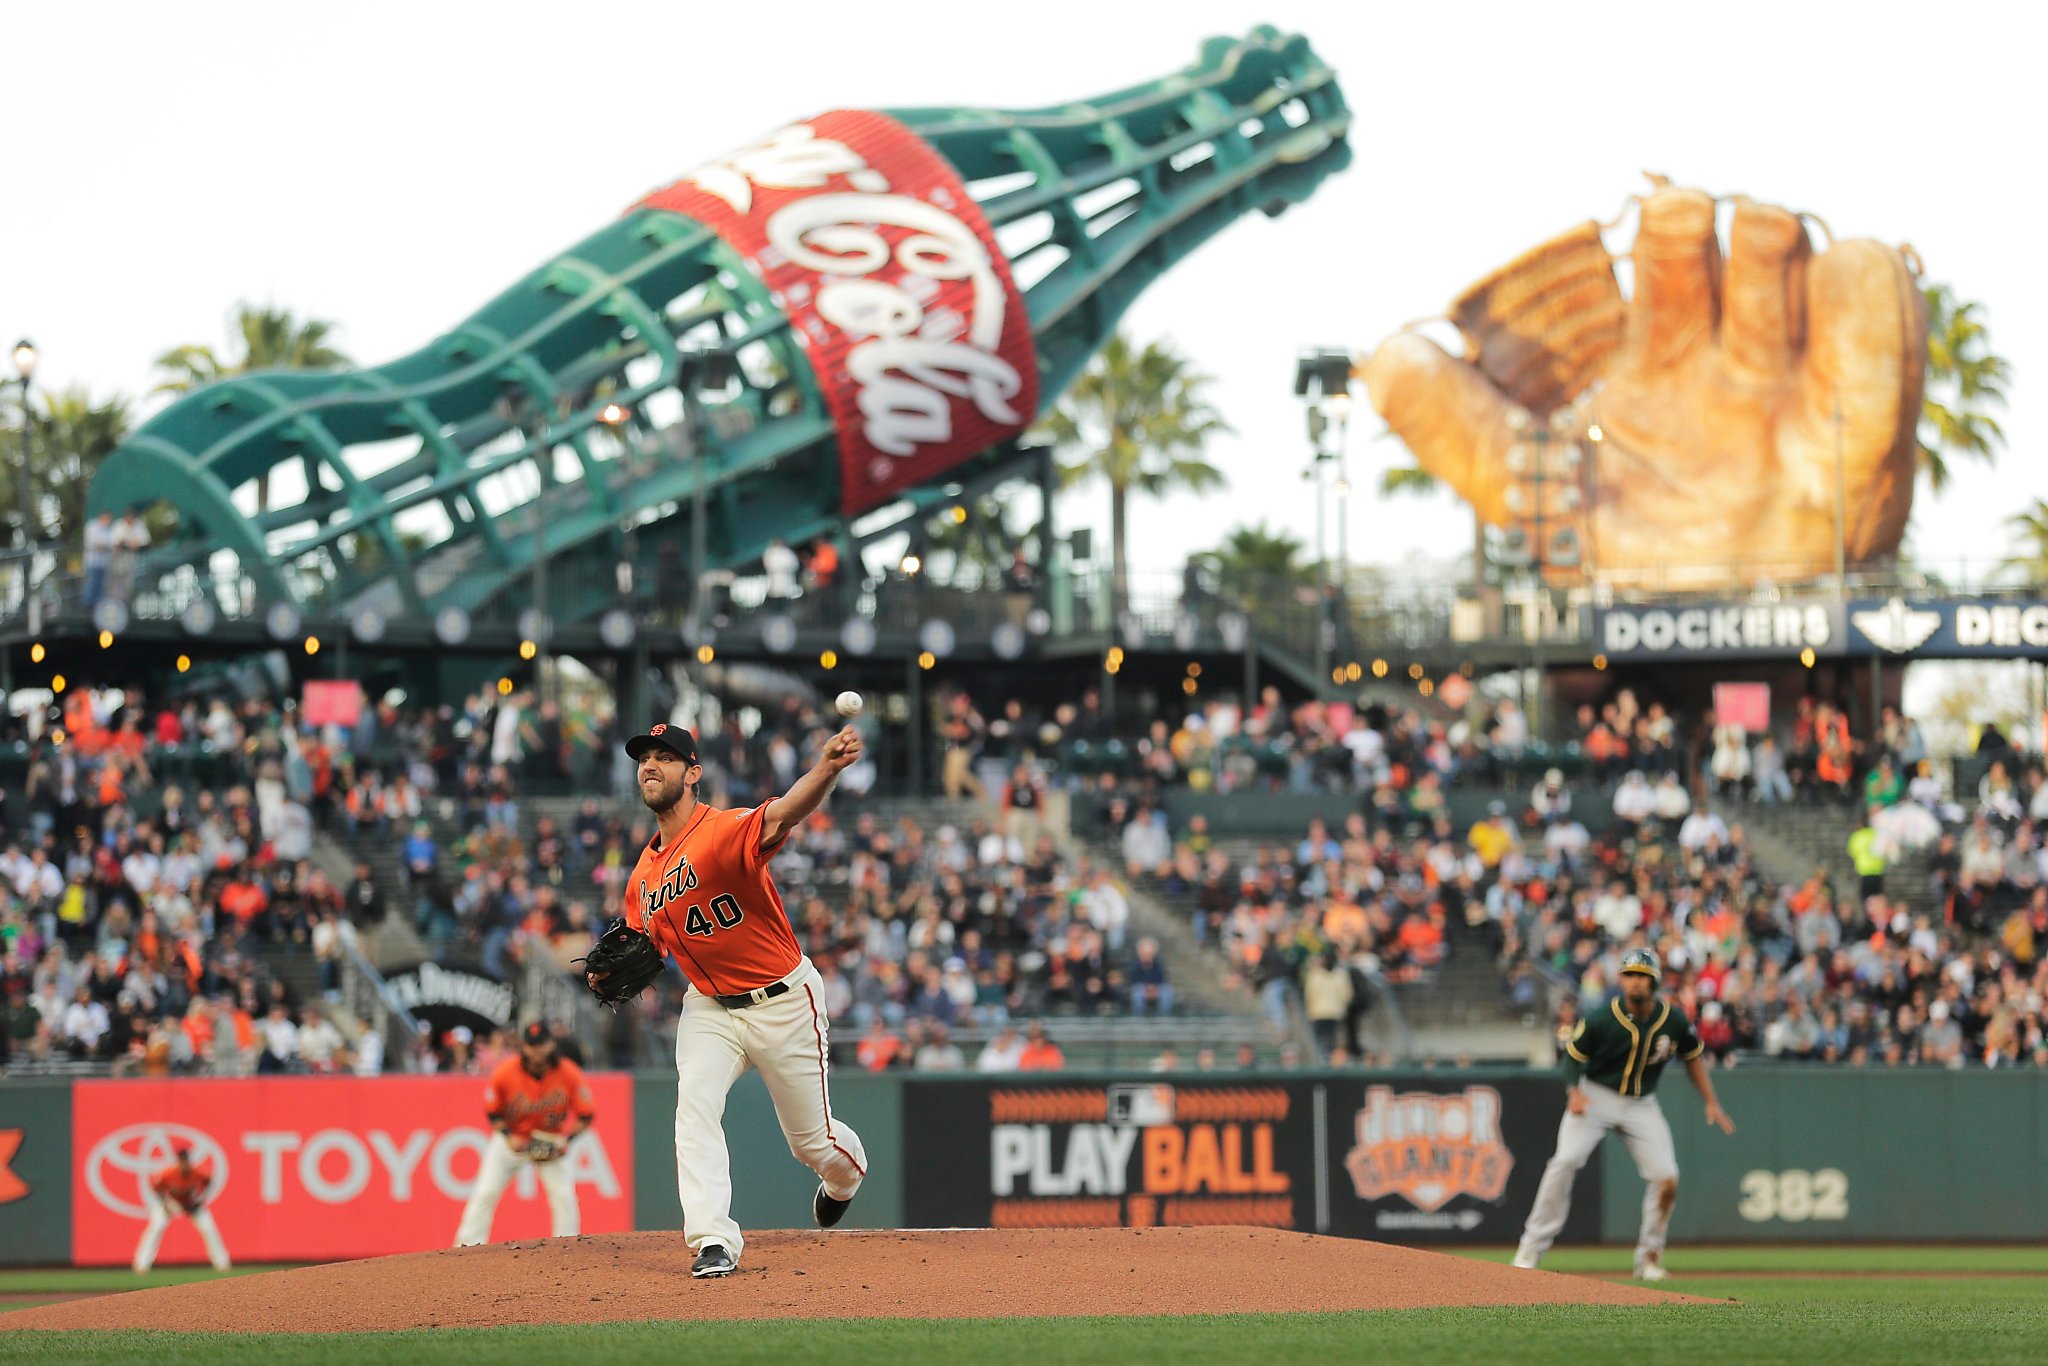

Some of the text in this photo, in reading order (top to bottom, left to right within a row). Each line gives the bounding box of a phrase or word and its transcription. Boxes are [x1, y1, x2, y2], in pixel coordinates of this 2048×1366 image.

[1604, 604, 1830, 651] DOCKERS
[684, 893, 744, 937] 40
[991, 1122, 1290, 1196] PLAY BALL
[1738, 1169, 1849, 1222] 382
